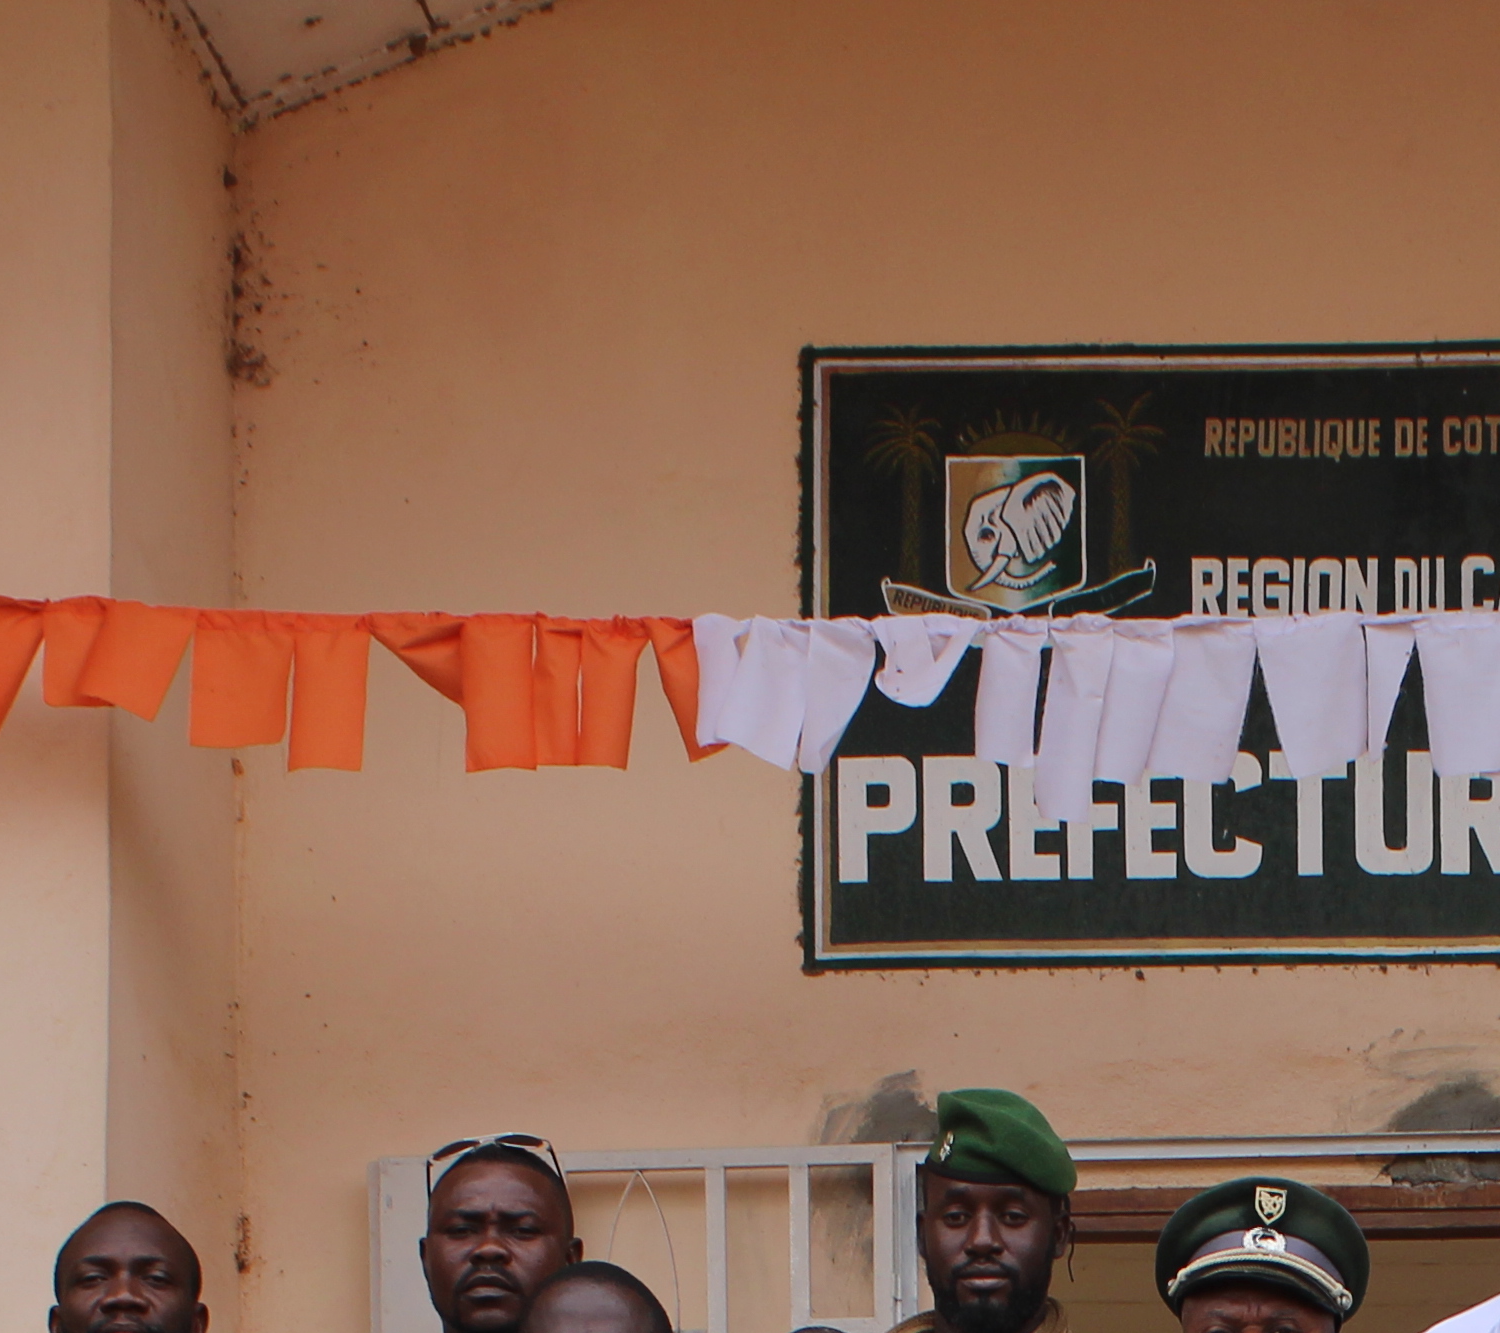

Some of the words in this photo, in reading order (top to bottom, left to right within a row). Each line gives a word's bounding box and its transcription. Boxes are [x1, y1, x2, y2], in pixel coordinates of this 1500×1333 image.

[1204, 418, 1380, 462] REPUBLIQUE
[1394, 418, 1427, 457] DE
[1191, 556, 1378, 617] REGION
[1394, 556, 1445, 614] DU
